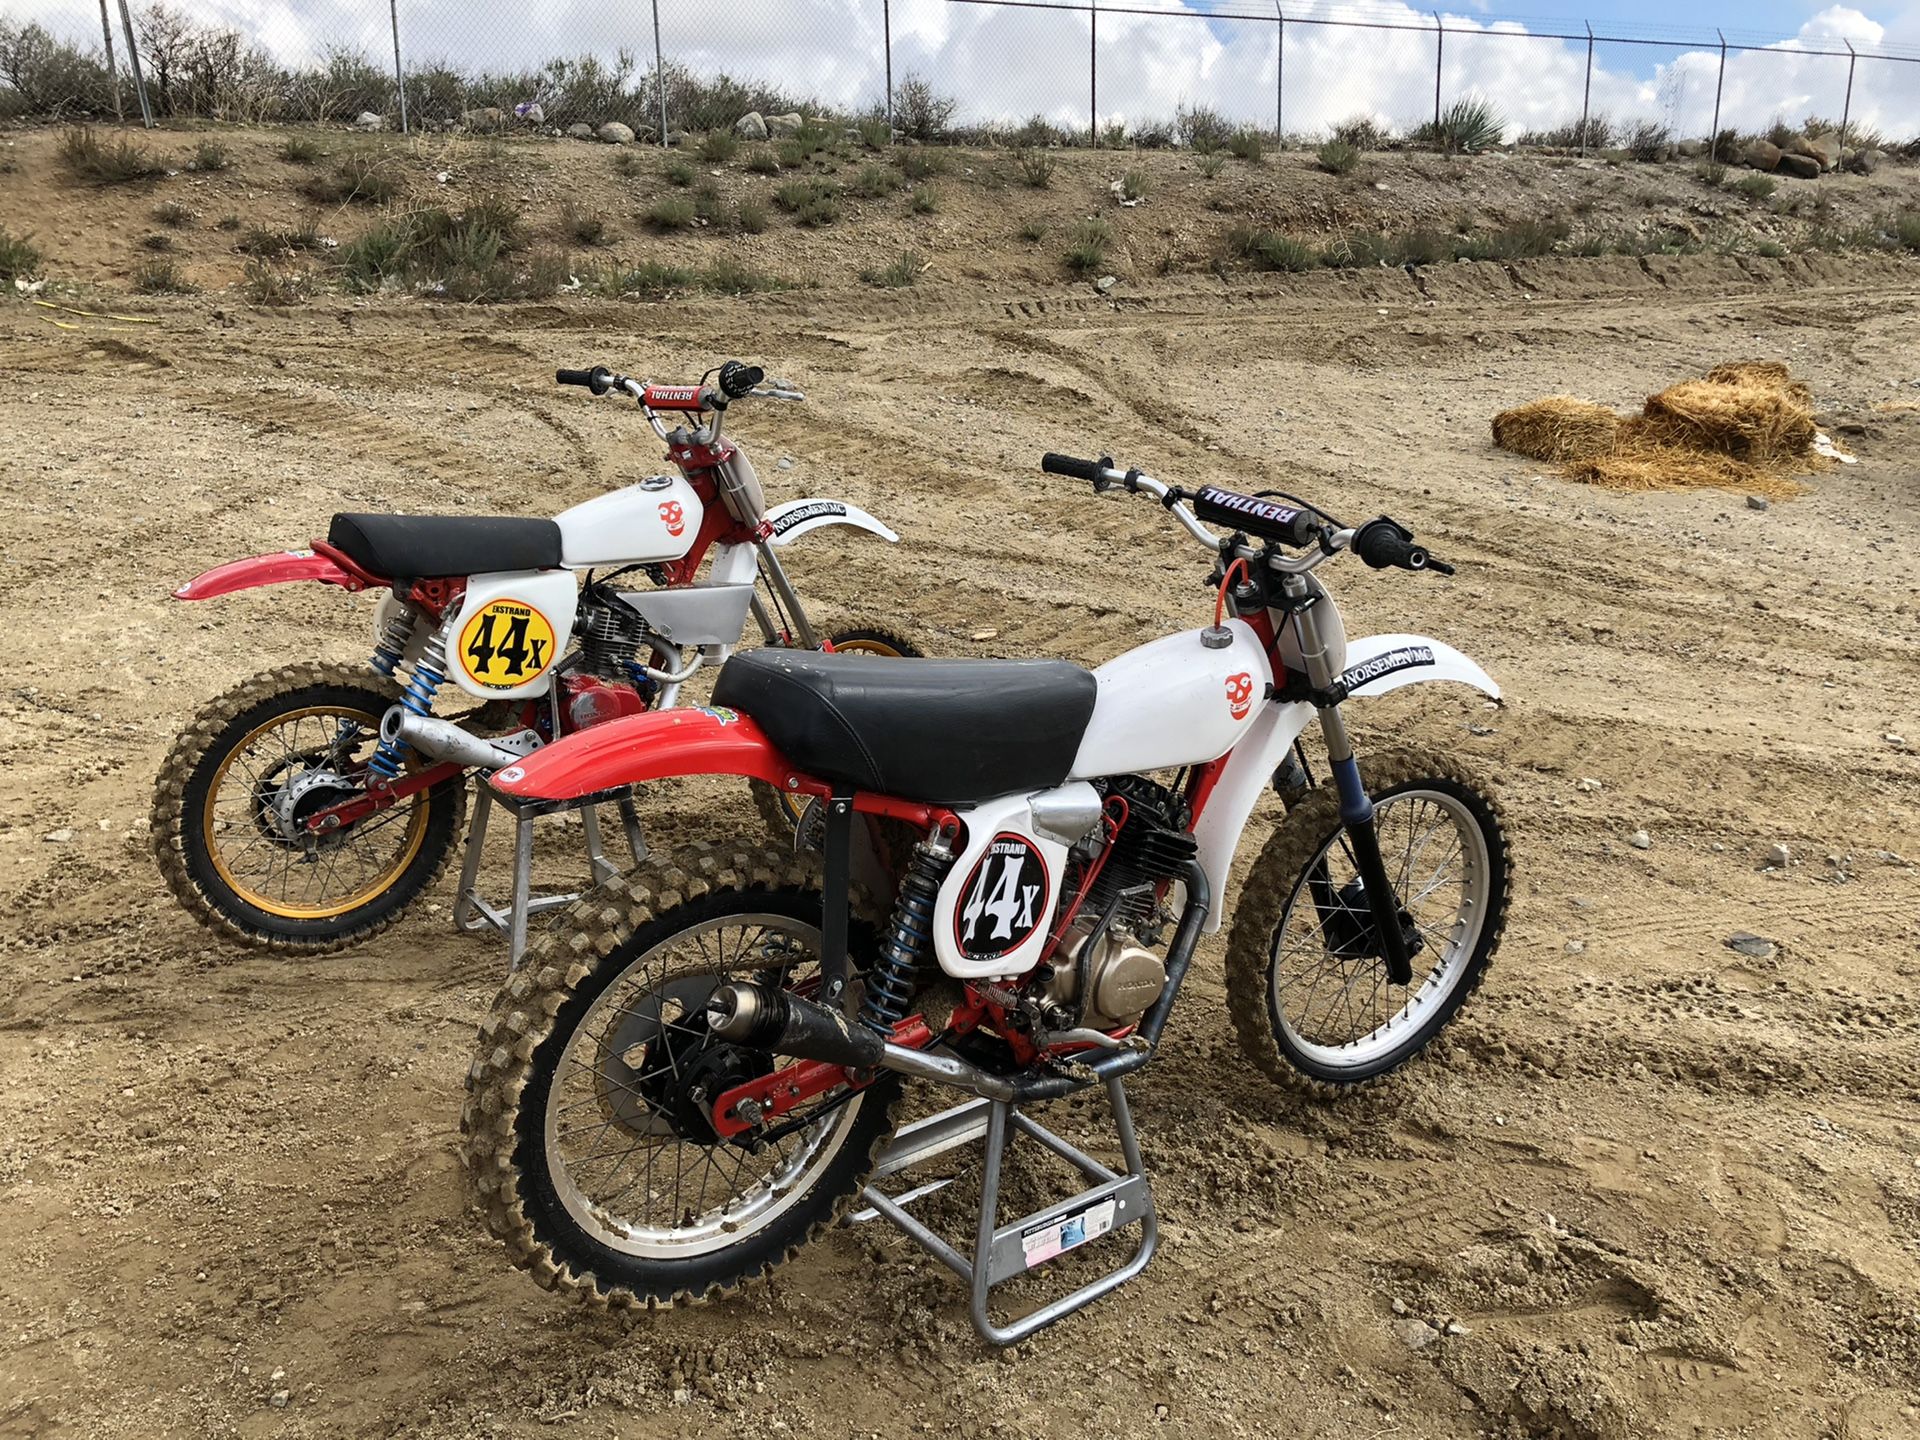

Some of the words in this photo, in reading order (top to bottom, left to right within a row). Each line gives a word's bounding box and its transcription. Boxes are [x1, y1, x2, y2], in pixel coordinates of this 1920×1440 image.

[650, 390, 694, 401] RENTHAL
[773, 502, 828, 533] NORSEMEN
[828, 503, 846, 514] MC
[1204, 488, 1297, 523] RENTHAL
[1344, 649, 1412, 687] NORSEMEN
[1412, 648, 1434, 662] MC
